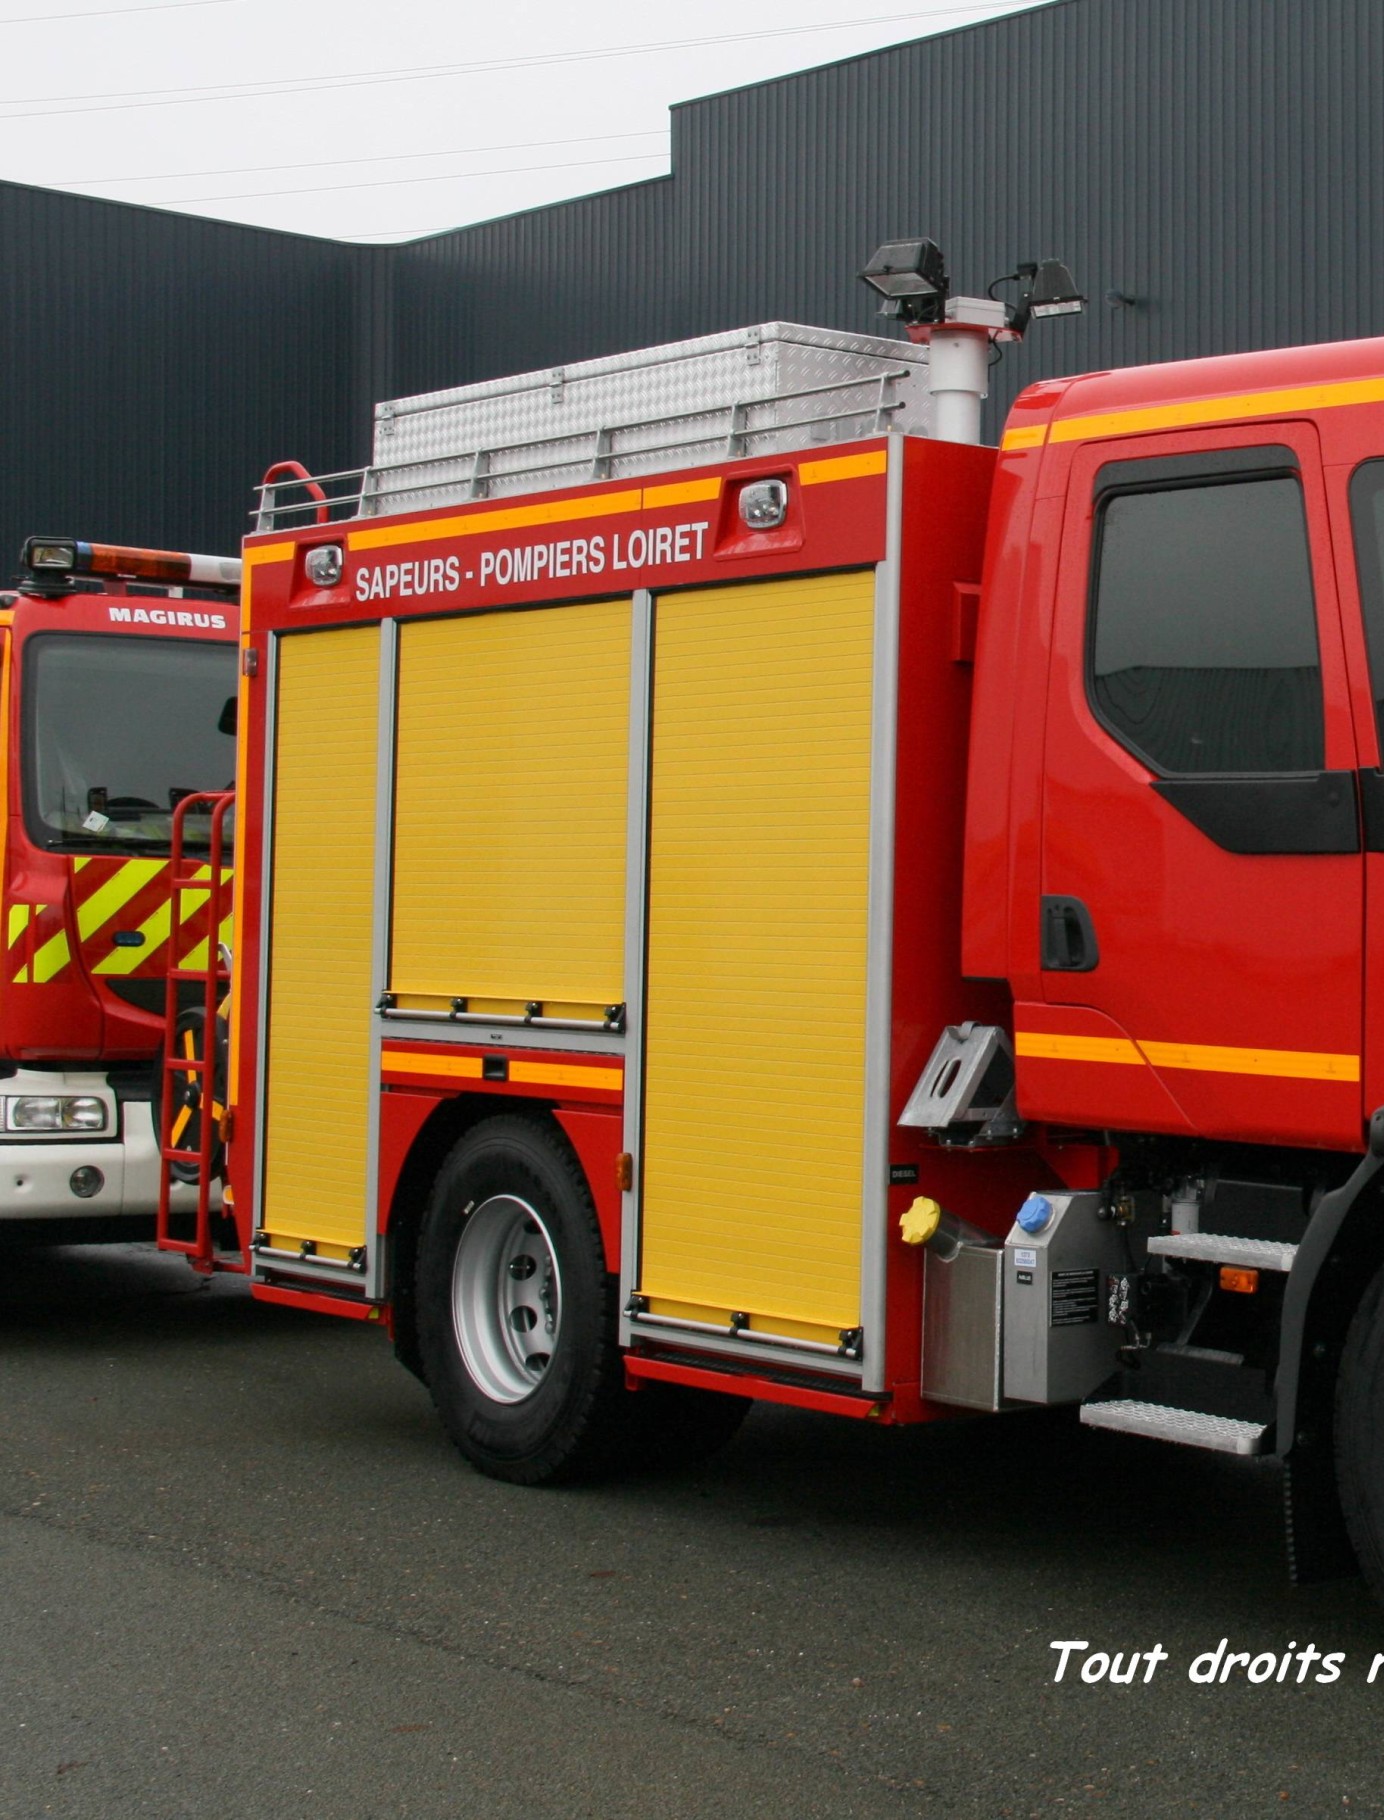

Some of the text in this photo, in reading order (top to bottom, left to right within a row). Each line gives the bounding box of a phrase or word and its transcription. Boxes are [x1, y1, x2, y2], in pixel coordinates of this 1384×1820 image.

[355, 556, 460, 602] SAPEURS
[480, 536, 605, 587] POMPIERS
[613, 521, 709, 570] LOIRET
[108, 607, 226, 629] MAGIRUS
